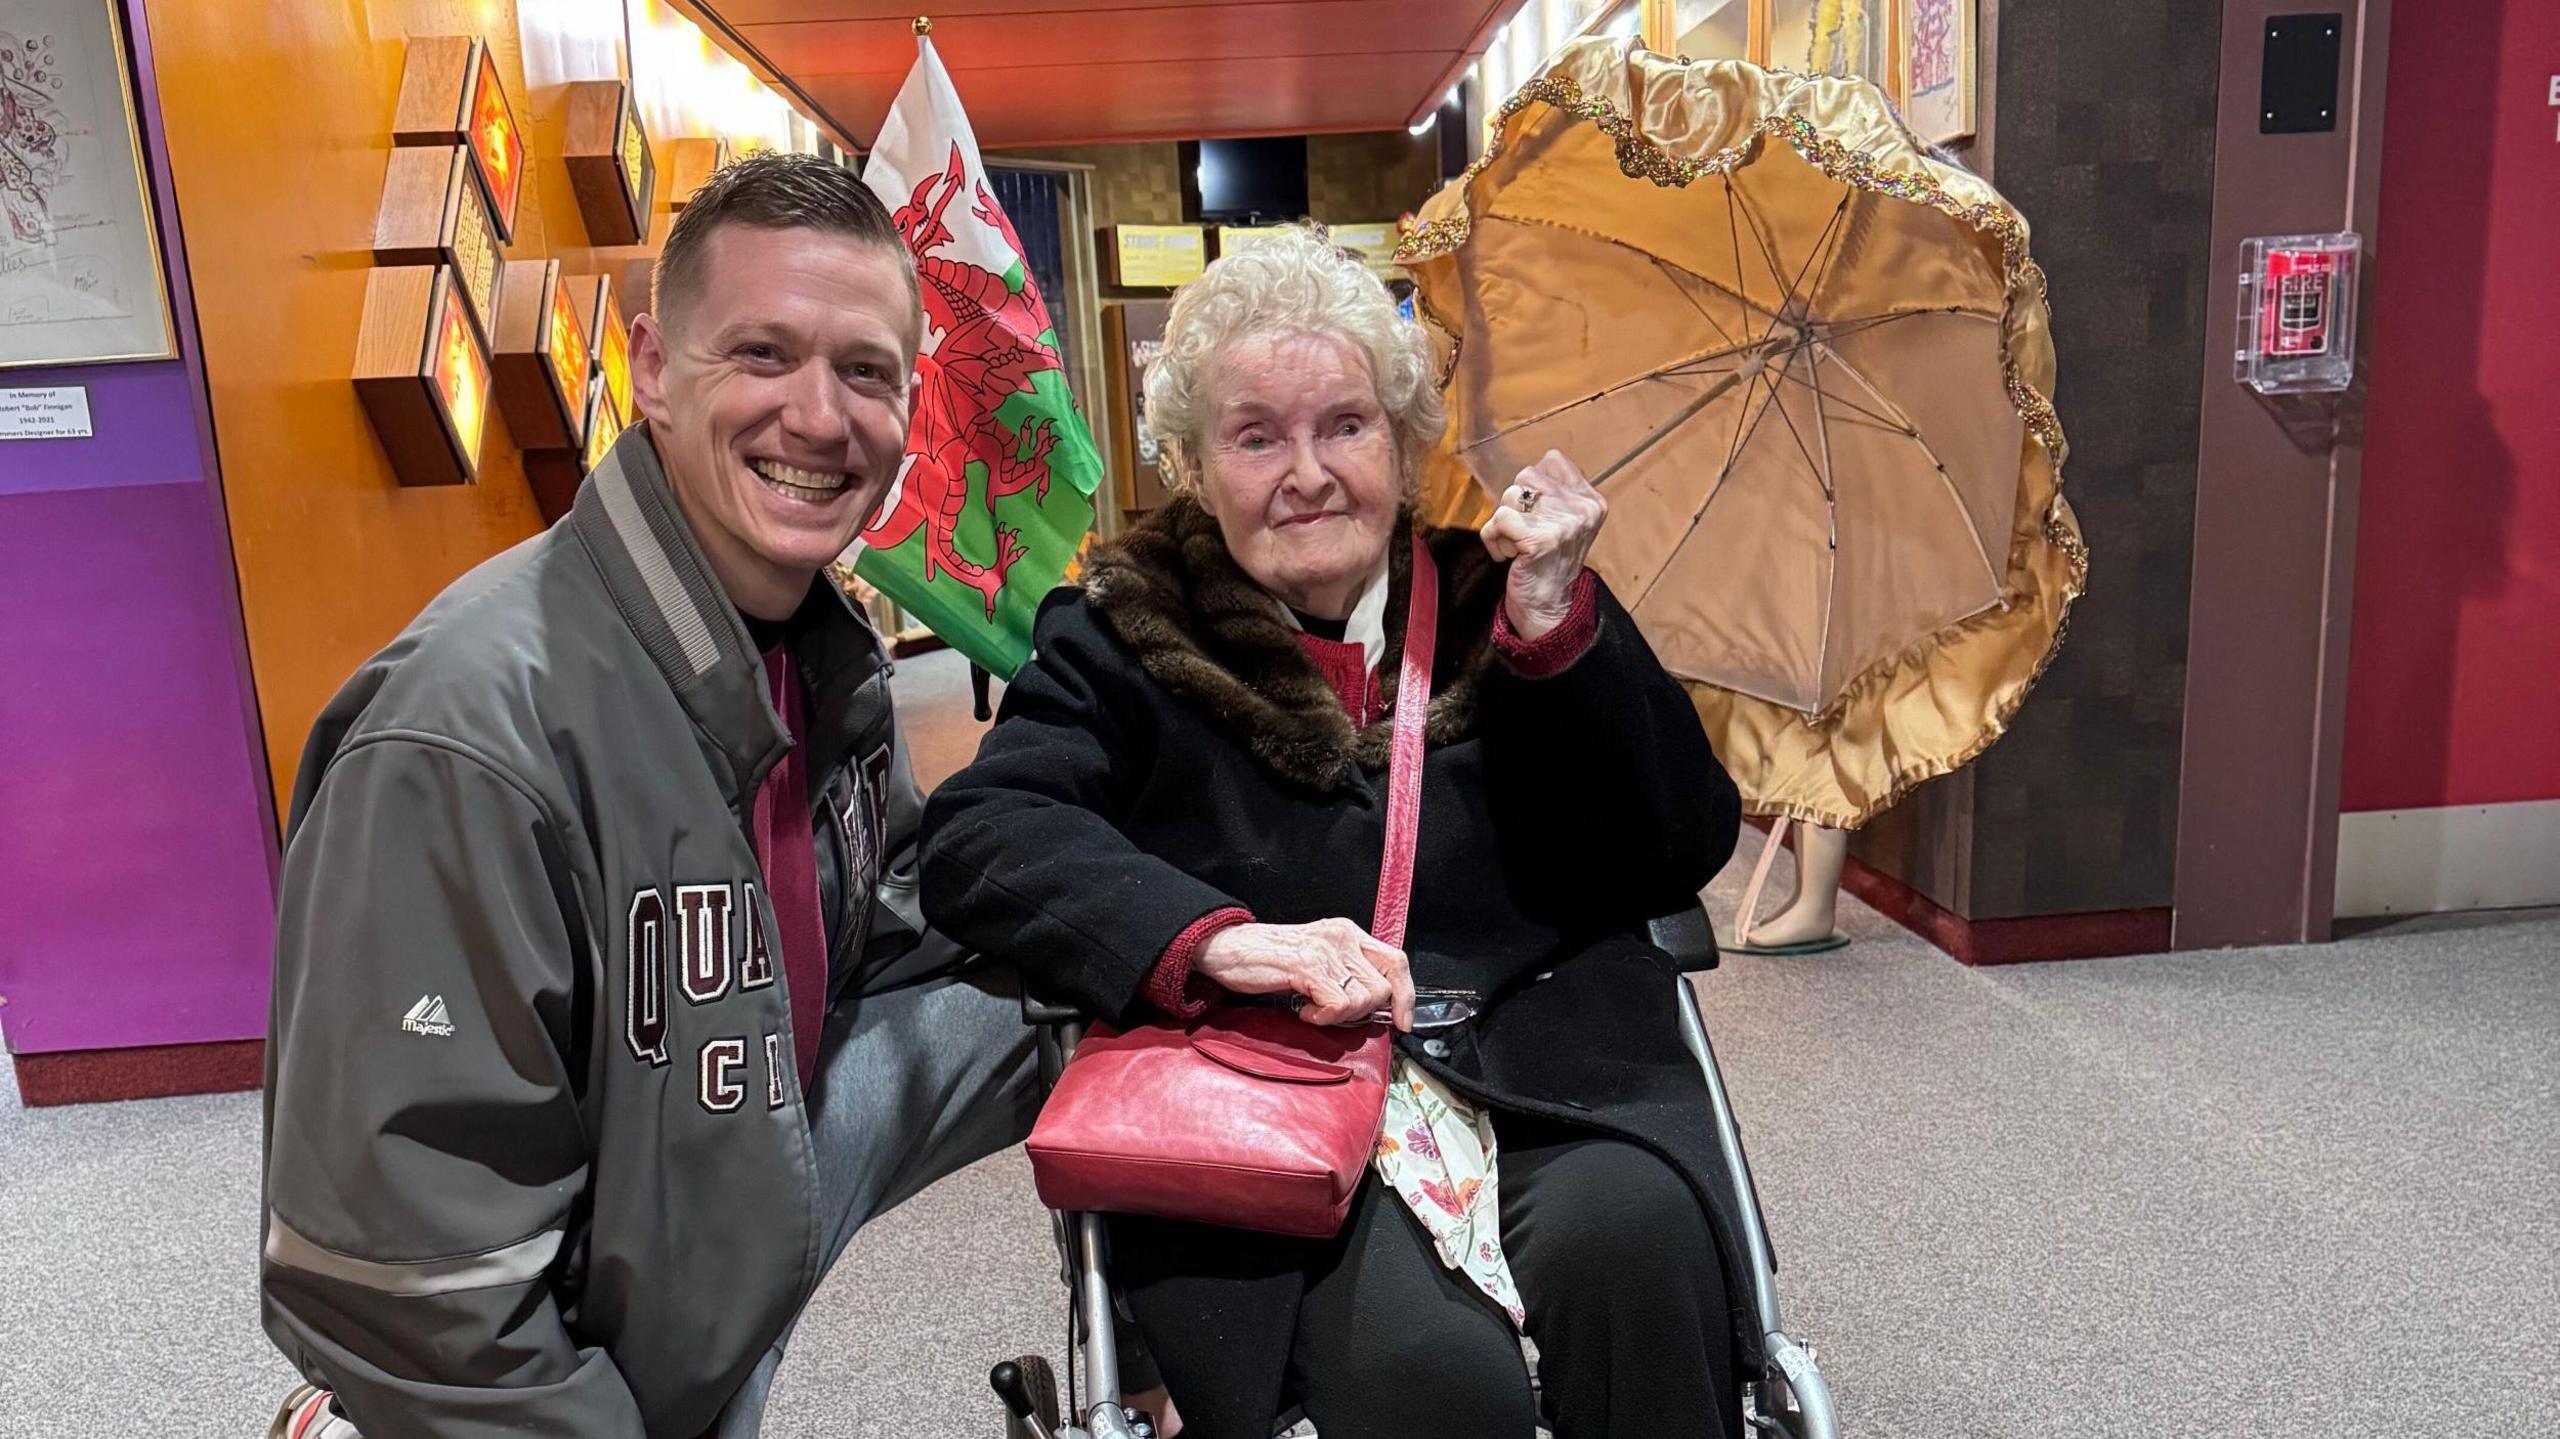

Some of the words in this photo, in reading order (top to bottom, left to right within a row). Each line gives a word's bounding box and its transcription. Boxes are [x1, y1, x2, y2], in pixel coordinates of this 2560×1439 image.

[2281, 273, 2324, 291] FIRE
[18, 391, 47, 399] Memory
[48, 390, 56, 398] of
[0, 404, 20, 412] obert
[43, 403, 73, 411] Finnigan
[24, 429, 54, 437] Designer
